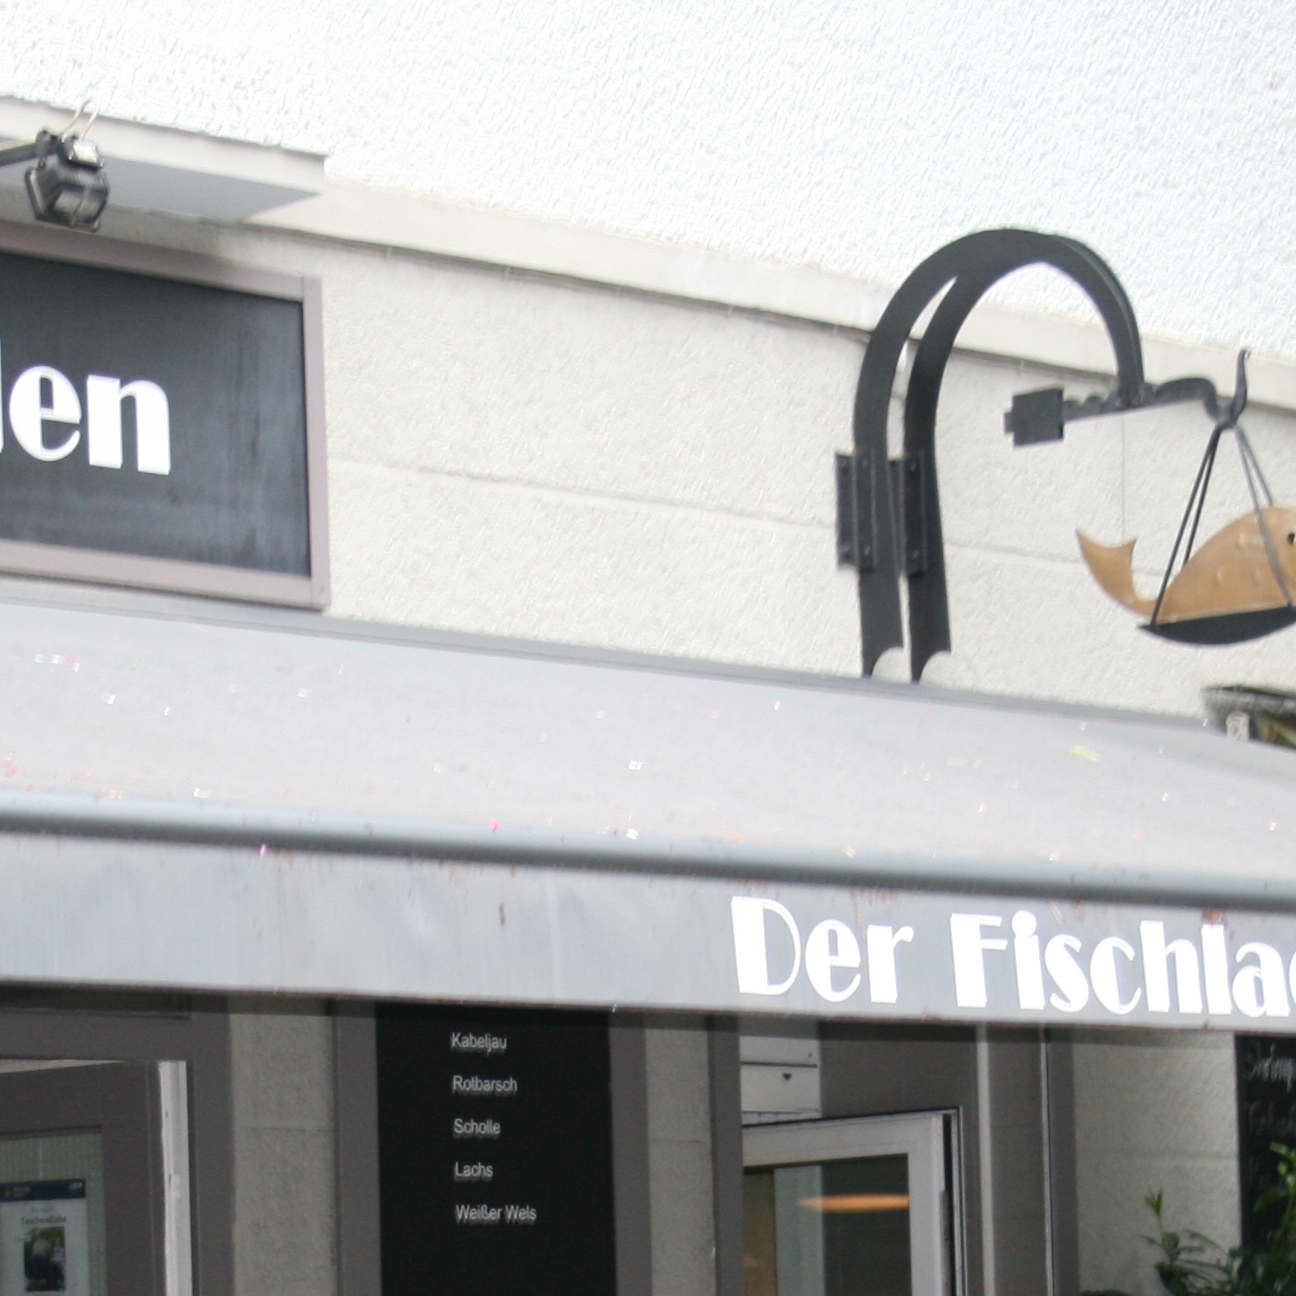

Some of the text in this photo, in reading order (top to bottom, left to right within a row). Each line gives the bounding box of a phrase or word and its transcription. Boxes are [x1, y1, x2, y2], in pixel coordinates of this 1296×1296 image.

[731, 895, 913, 1003] Der
[451, 1032, 507, 1054] Kabeljau
[452, 1074, 518, 1094] Rotbarsch
[454, 1117, 501, 1137] Scholle
[454, 1161, 494, 1180] Lachs
[455, 1203, 538, 1223] Weißer Wels
